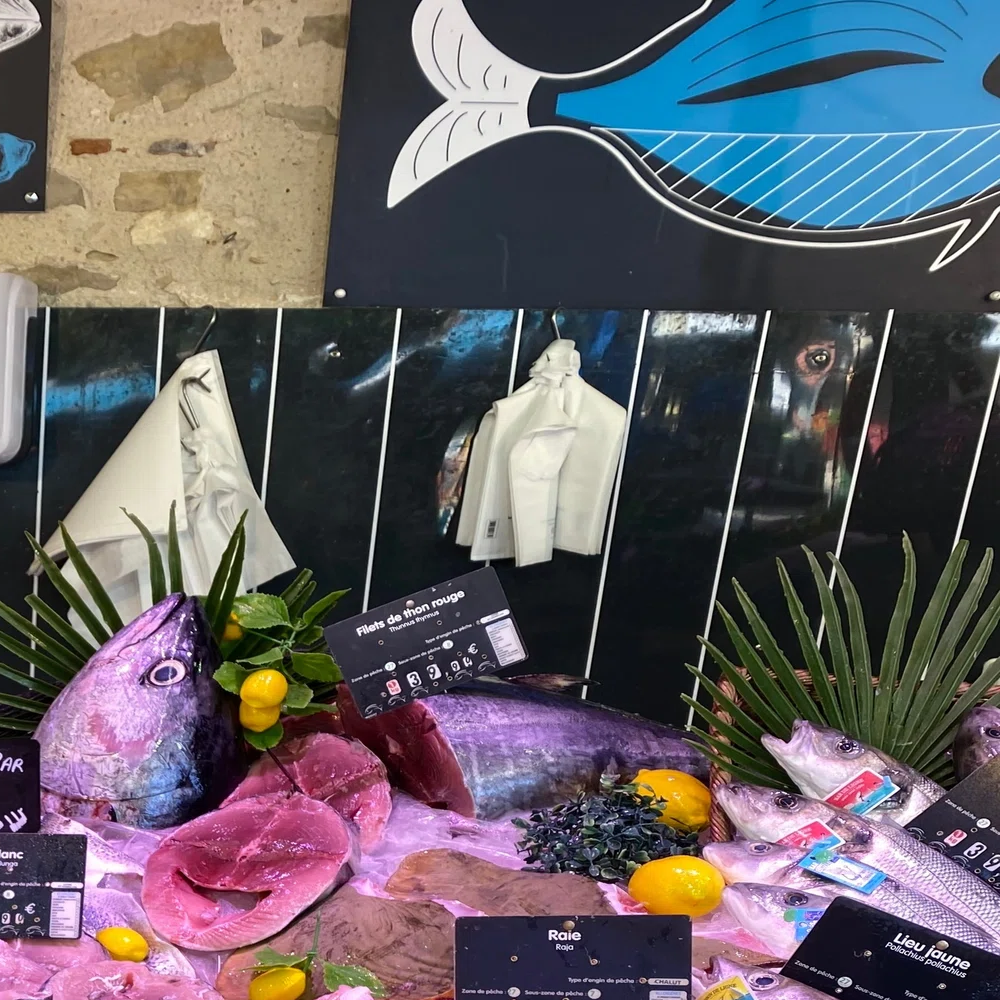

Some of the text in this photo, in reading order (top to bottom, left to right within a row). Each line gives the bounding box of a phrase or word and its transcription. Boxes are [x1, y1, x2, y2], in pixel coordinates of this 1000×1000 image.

[356, 590, 465, 636] Filets de thon rouge
[389, 610, 439, 632] Thunnus thynnus
[24, 903, 36, 914] €
[548, 930, 581, 940] Raie
[885, 942, 967, 978] Pollachius pollachius
[893, 933, 971, 970] Lieu jaune
[795, 960, 809, 969] Zone
[817, 970, 835, 980] pêche
